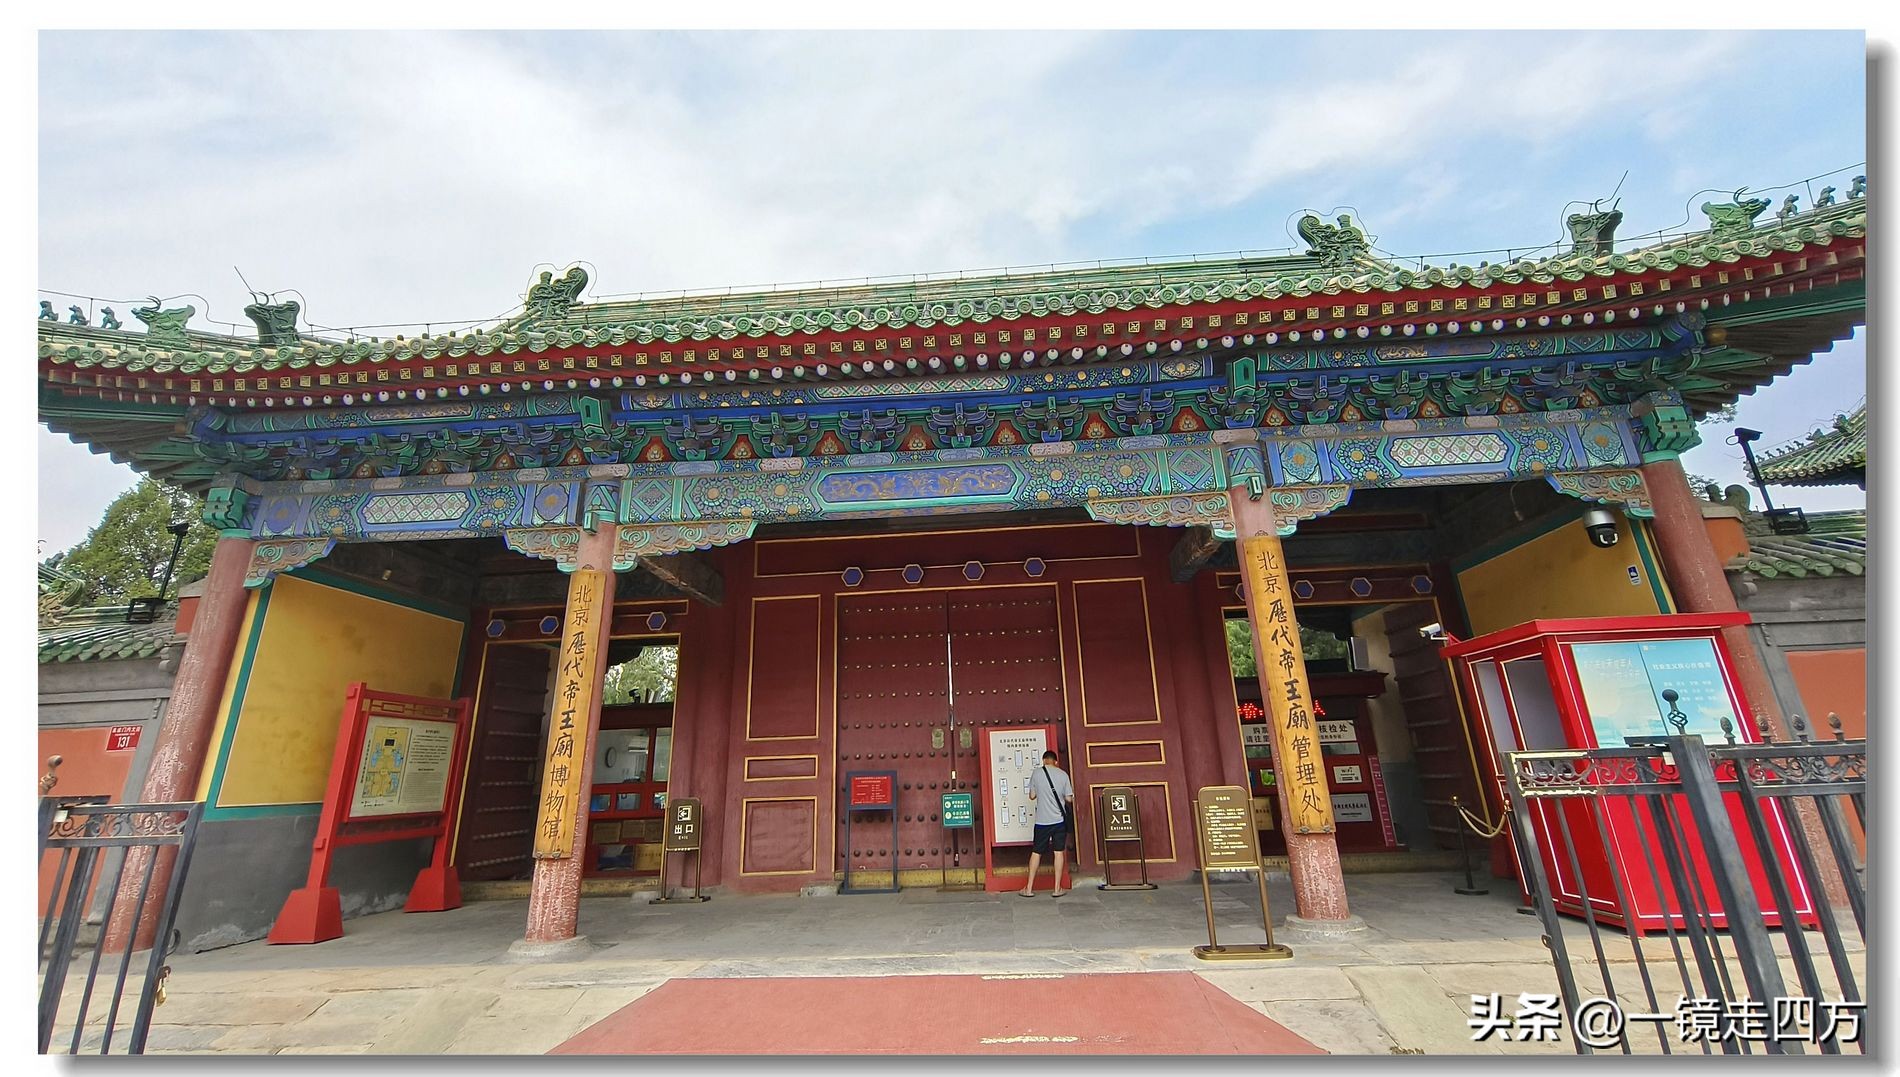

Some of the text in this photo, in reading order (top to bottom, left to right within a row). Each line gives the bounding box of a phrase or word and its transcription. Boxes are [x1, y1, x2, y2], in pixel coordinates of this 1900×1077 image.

[117, 736, 130, 748] 131
[1111, 814, 1131, 824] 入口
[674, 824, 694, 835] 出口
